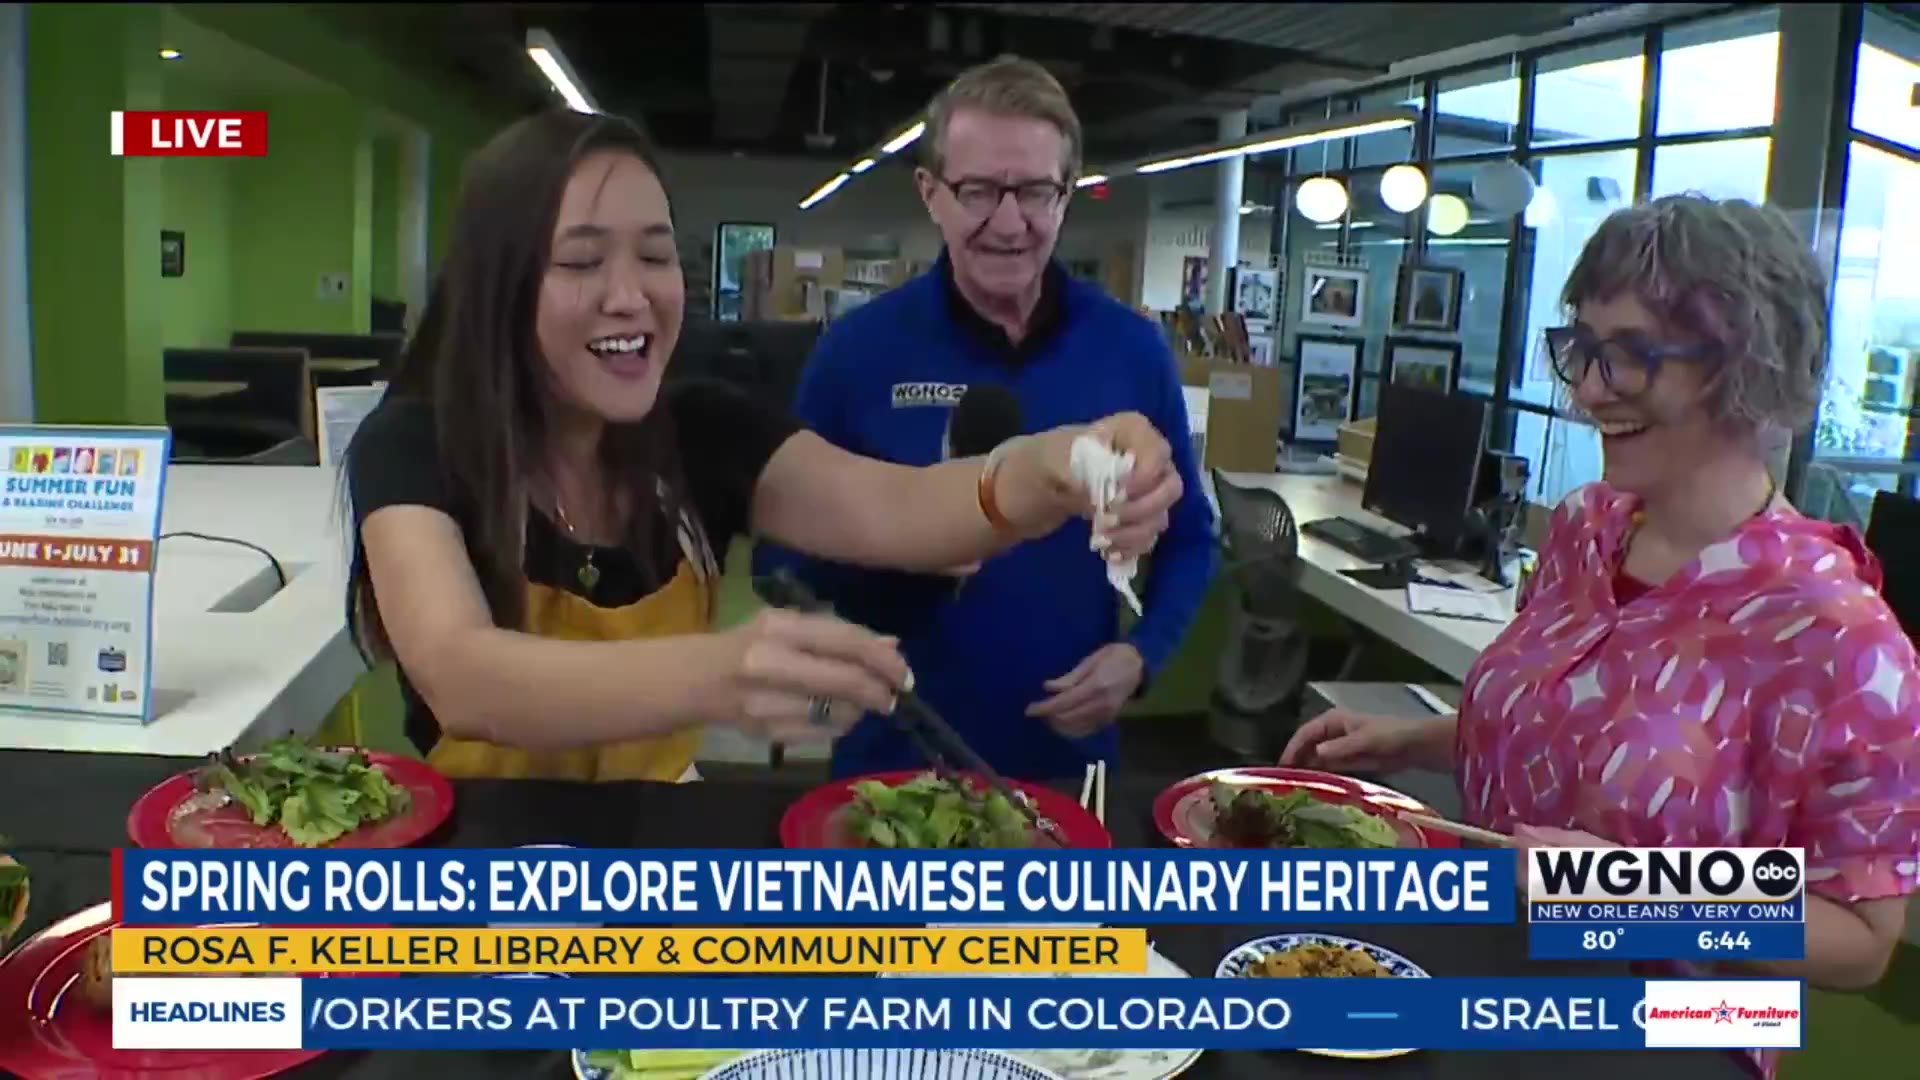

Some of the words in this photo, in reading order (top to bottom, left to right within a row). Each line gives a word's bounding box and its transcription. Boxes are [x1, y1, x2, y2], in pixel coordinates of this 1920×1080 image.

[895, 384, 950, 399] WGNO
[6, 477, 87, 495] SUMMER
[95, 480, 136, 497] FUN
[67, 499, 134, 512] CHALLENGE
